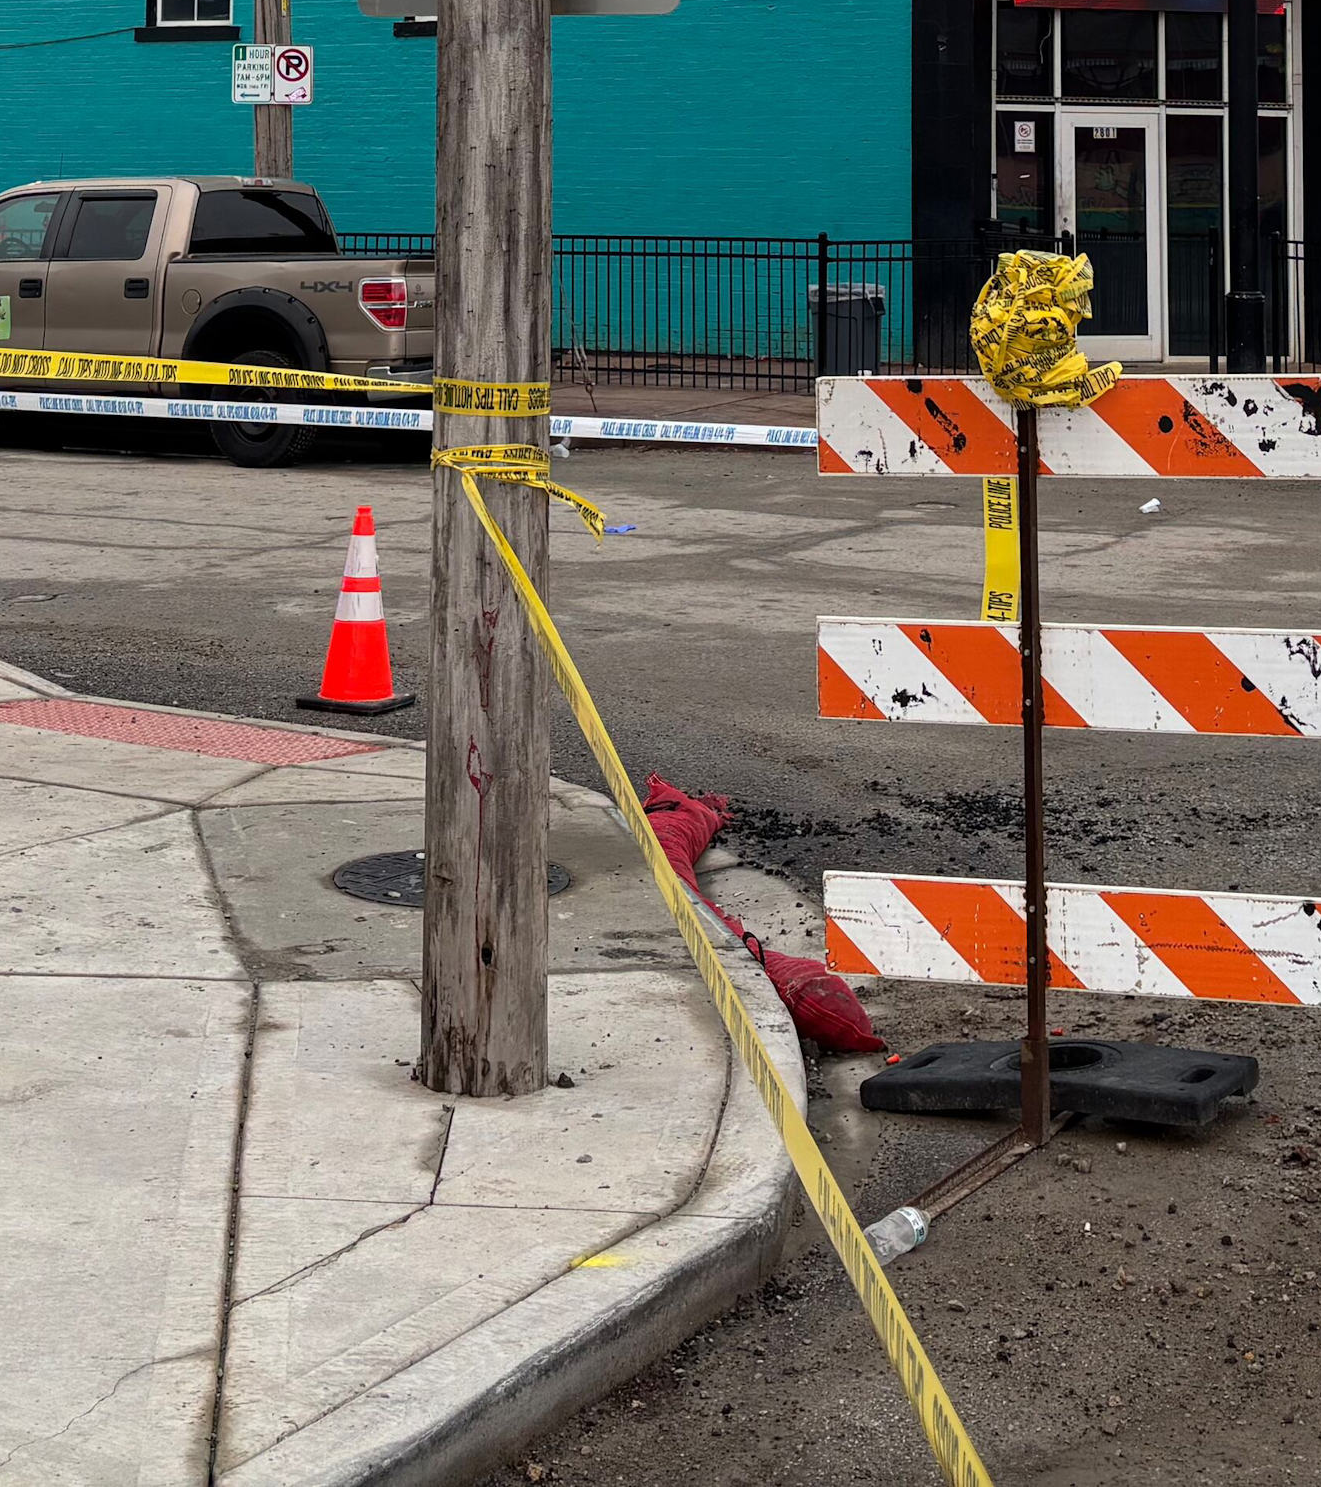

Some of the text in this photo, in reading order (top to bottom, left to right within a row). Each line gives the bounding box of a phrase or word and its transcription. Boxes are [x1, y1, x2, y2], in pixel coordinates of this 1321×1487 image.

[249, 49, 270, 59] HOUR
[237, 63, 270, 72] PARKING
[237, 73, 270, 82] 7AM-6PM
[1094, 127, 1116, 139] 2801
[9, 354, 28, 375] NOT
[25, 356, 52, 376] CROSS
[56, 357, 76, 378] CALL
[76, 359, 95, 379] TIPS
[93, 360, 124, 380] HOTLINE
[1091, 366, 1117, 393] CALL
[475, 387, 495, 410] TIPS
[498, 388, 518, 411] CALL
[660, 424, 672, 438] CALL
[987, 479, 1013, 531] POLICE LINE
